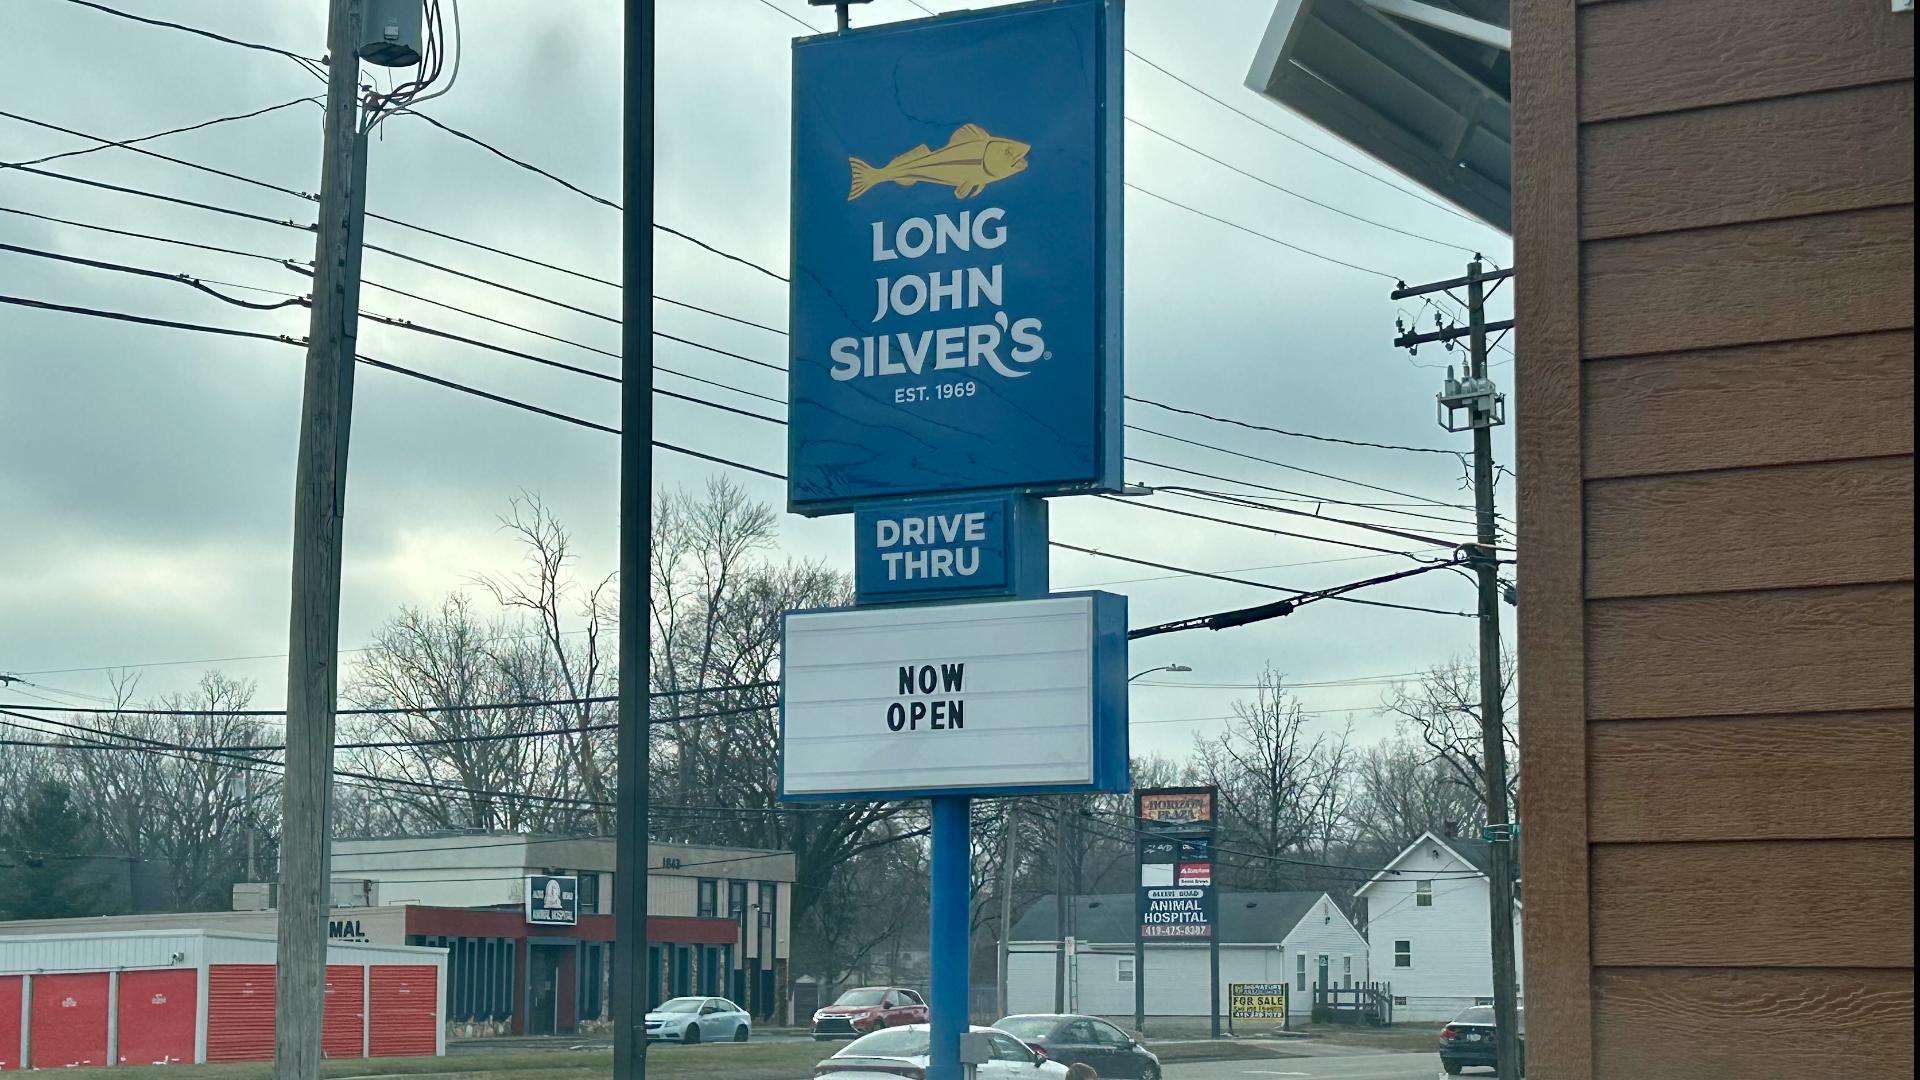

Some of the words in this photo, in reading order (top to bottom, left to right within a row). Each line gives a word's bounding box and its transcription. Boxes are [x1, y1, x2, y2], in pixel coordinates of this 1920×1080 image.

[872, 207, 1007, 262] LONG
[872, 264, 1003, 323] JOHN
[895, 386, 930, 403] EST.
[936, 381, 976, 400] 1969
[877, 511, 986, 548] DRIVE
[881, 547, 980, 581] THRU
[899, 663, 964, 695] NOW
[887, 700, 964, 732] OPEN
[1144, 912, 1208, 923] HOSPITAL
[1151, 900, 1202, 912] ANIMAL
[1233, 996, 1254, 1006] FOR
[1257, 996, 1284, 1006] SALE
